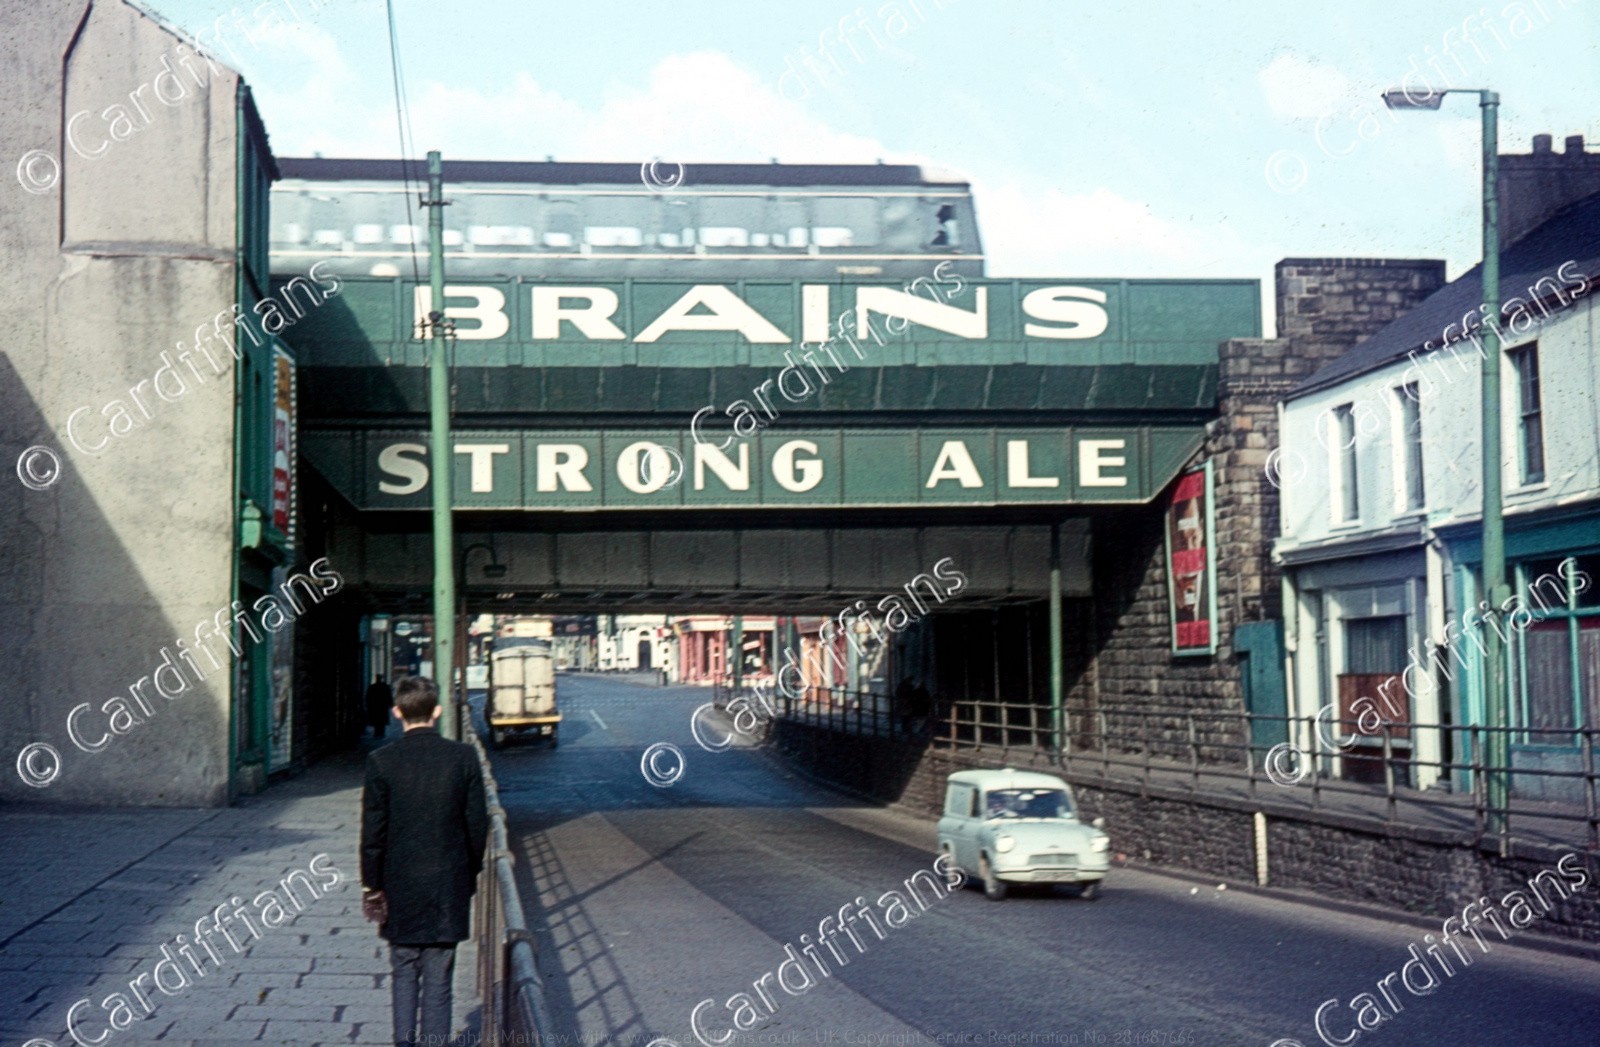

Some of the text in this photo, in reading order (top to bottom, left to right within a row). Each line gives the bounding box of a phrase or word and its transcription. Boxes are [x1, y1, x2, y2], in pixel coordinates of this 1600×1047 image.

[414, 285, 1108, 343] BRAINS
[379, 439, 1127, 495] STRONG ALE
